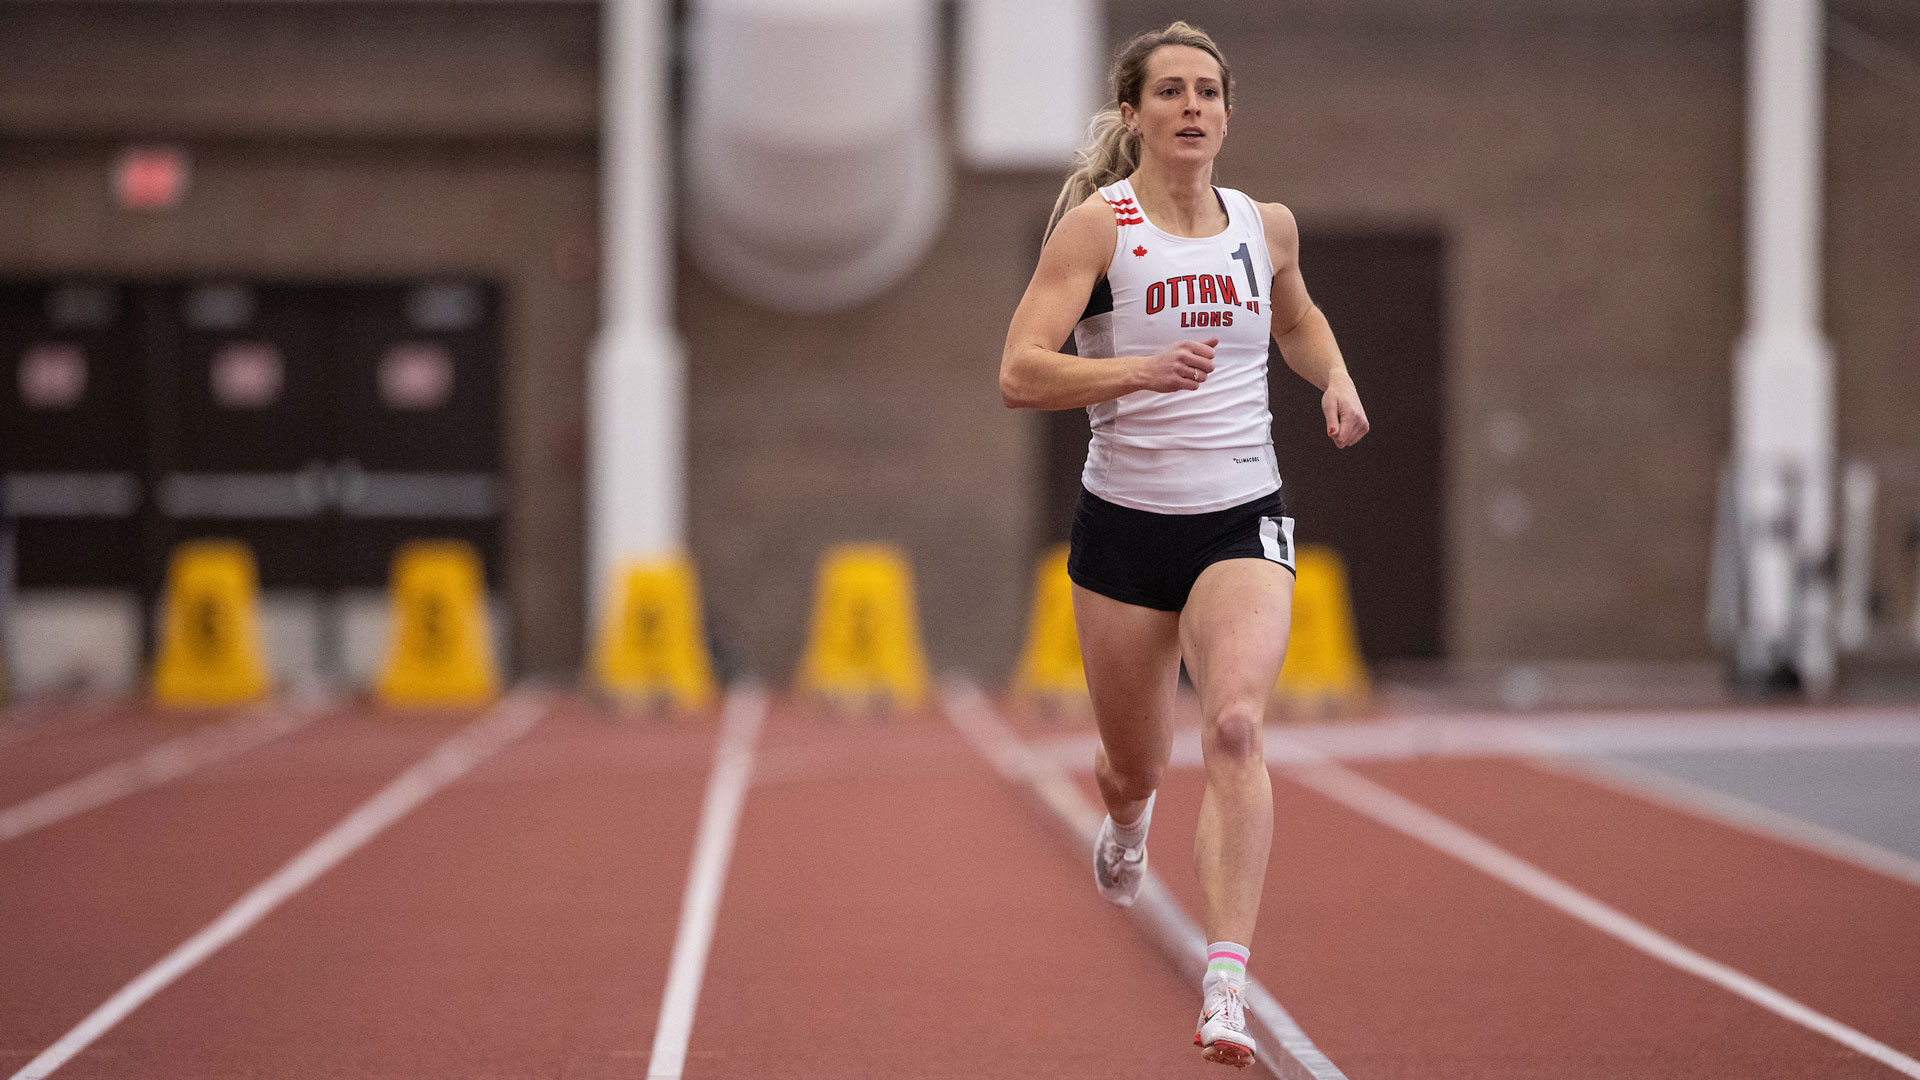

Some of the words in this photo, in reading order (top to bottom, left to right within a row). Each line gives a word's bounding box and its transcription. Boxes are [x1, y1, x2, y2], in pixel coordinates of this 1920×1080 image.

[1231, 242, 1260, 298] 1
[1146, 274, 1260, 315] OTTAW
[1180, 311, 1233, 328] LIONS
[1268, 516, 1289, 561] 1
